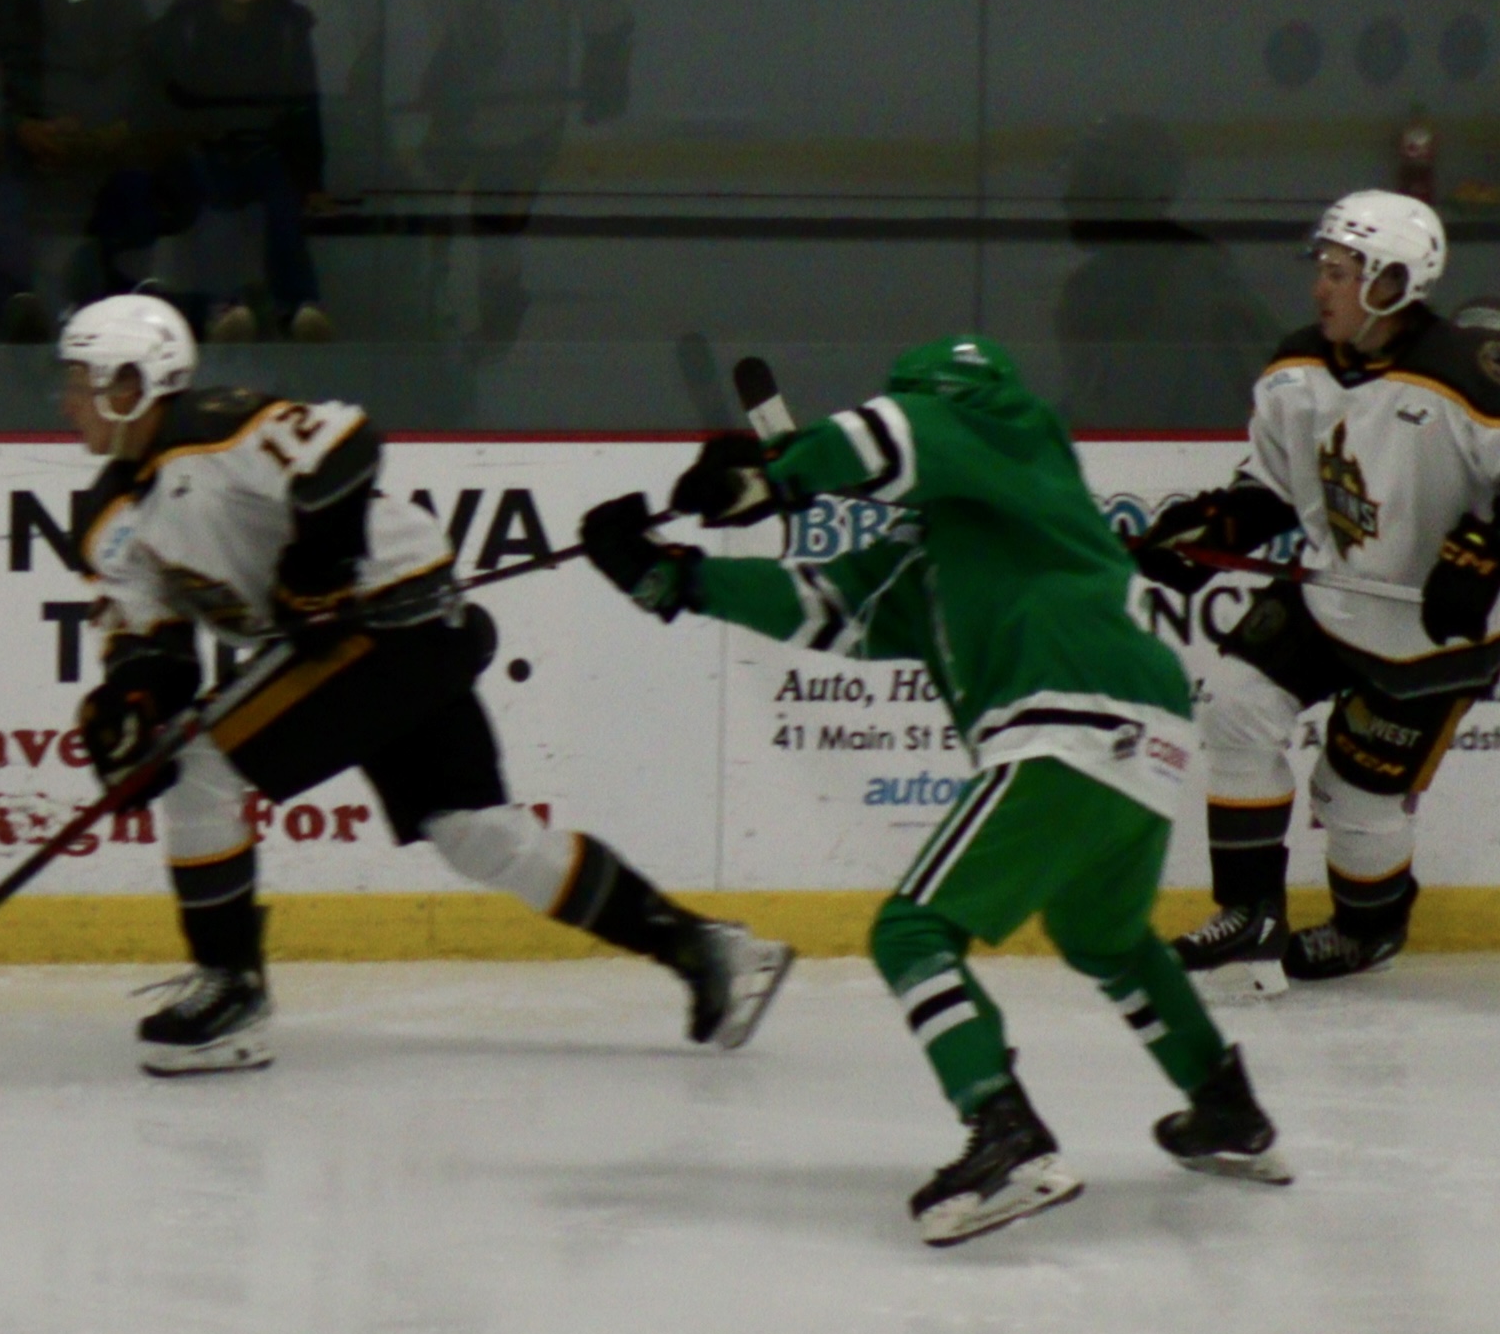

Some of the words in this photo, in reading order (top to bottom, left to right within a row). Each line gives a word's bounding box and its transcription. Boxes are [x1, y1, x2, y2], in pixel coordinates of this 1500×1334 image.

[260, 404, 326, 467] 12
[774, 669, 874, 708] Auto,
[772, 725, 804, 750] 41
[818, 725, 895, 750] Main
[905, 725, 932, 750] St
[241, 791, 370, 844] For
